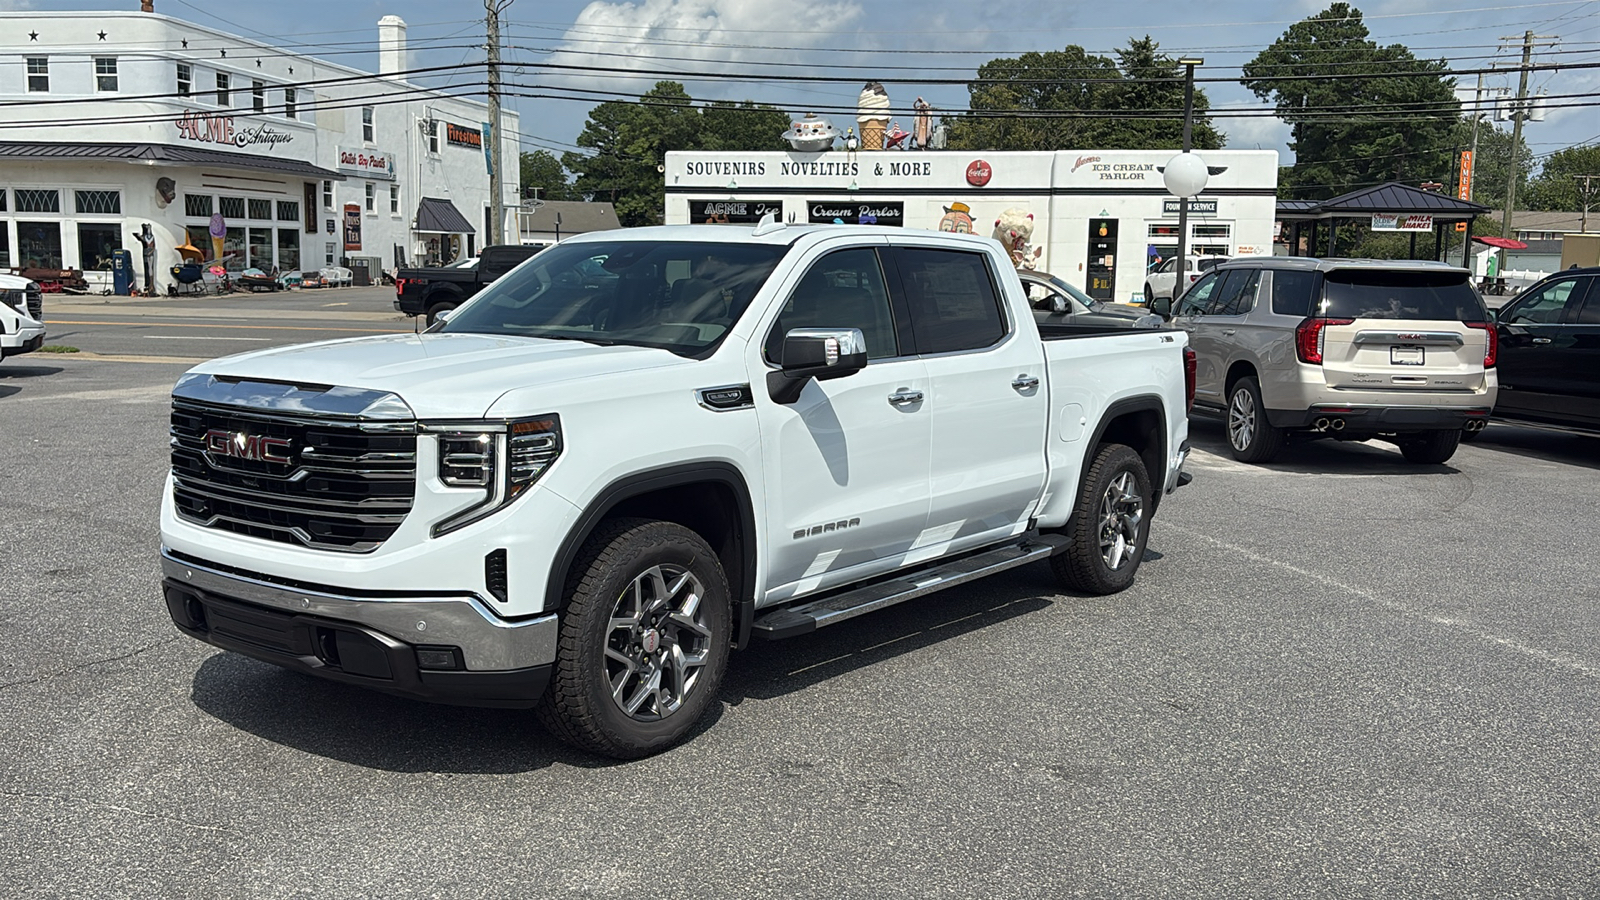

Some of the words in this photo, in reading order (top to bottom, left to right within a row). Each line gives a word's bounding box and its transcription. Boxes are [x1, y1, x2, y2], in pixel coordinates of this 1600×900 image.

[175, 109, 235, 145] ACME
[447, 123, 481, 145] Firestone
[341, 151, 356, 165] Dutch
[358, 153, 369, 169] Boy
[369, 154, 386, 169] Paints
[686, 161, 765, 176] SOUVENIRS
[780, 161, 859, 176] NOVELTIES
[873, 162, 884, 176] &
[890, 162, 931, 176] MORE
[704, 203, 747, 215] ACME
[755, 204, 780, 215] Ice
[812, 205, 852, 217] Cream
[858, 205, 901, 217] Parlor
[1165, 202, 1192, 211] FOUNN
[1193, 202, 1215, 211] SERVICE
[347, 230, 359, 242] TEA
[207, 429, 292, 465] GMC
[793, 518, 860, 540] SIERRA
